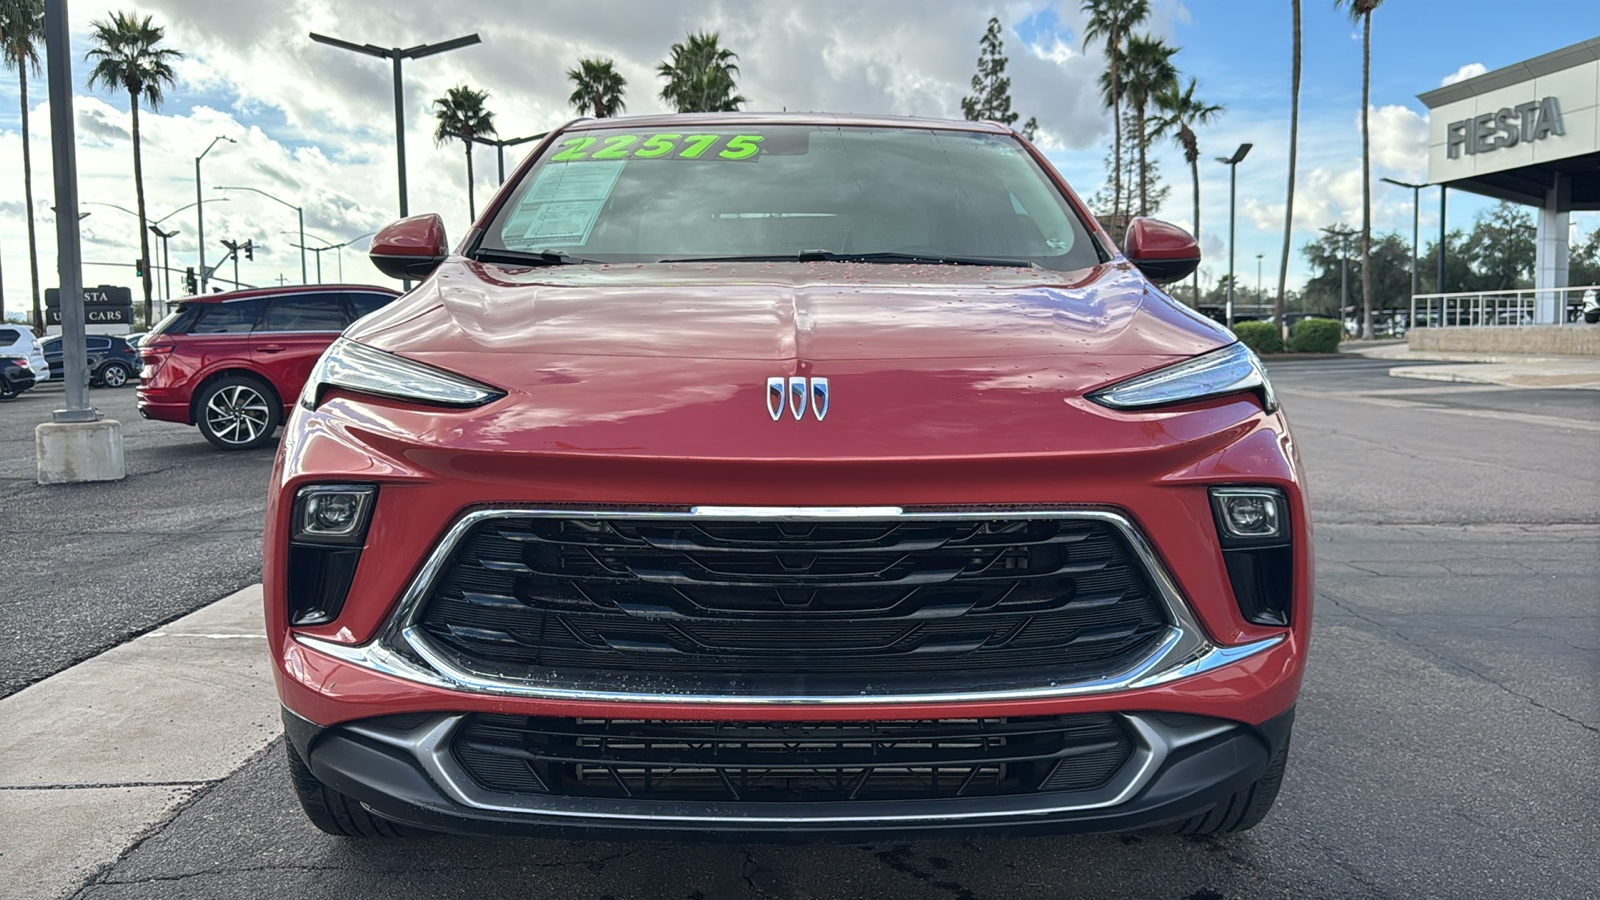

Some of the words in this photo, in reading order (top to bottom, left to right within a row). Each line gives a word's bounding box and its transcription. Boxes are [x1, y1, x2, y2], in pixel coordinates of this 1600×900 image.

[1447, 96, 1566, 160] FIESTA
[84, 292, 108, 301] STA
[89, 311, 121, 320] CARS
